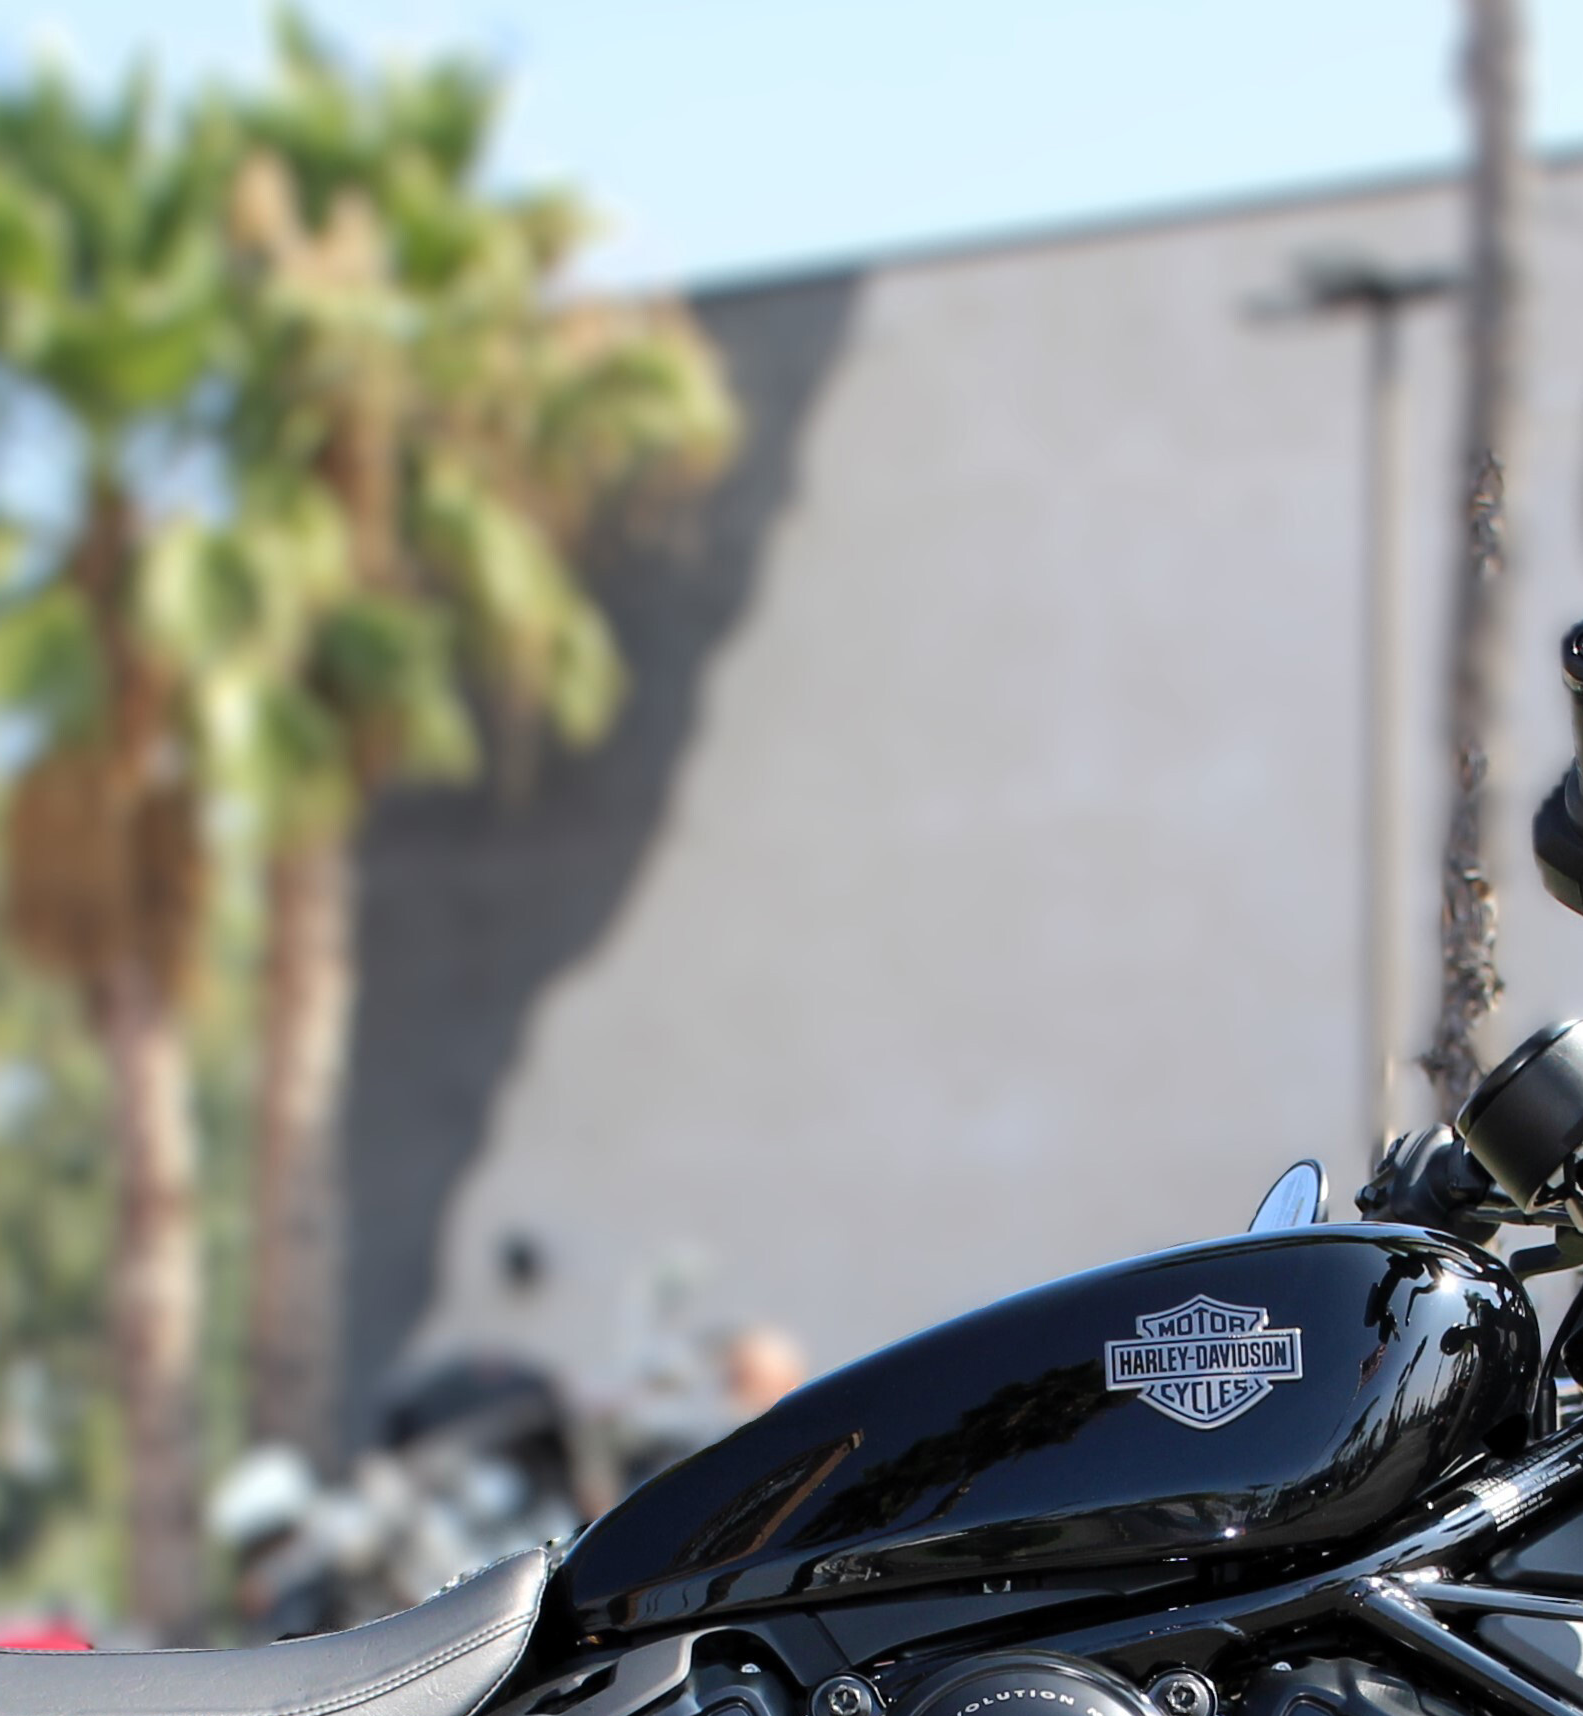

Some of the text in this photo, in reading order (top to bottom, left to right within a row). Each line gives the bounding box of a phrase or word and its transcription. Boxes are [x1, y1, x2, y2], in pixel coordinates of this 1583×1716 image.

[1158, 1307, 1246, 1337] MOTOR
[1119, 1340, 1287, 1376] HARLEY-DAVIDSON
[1160, 1379, 1247, 1415] CYCLES
